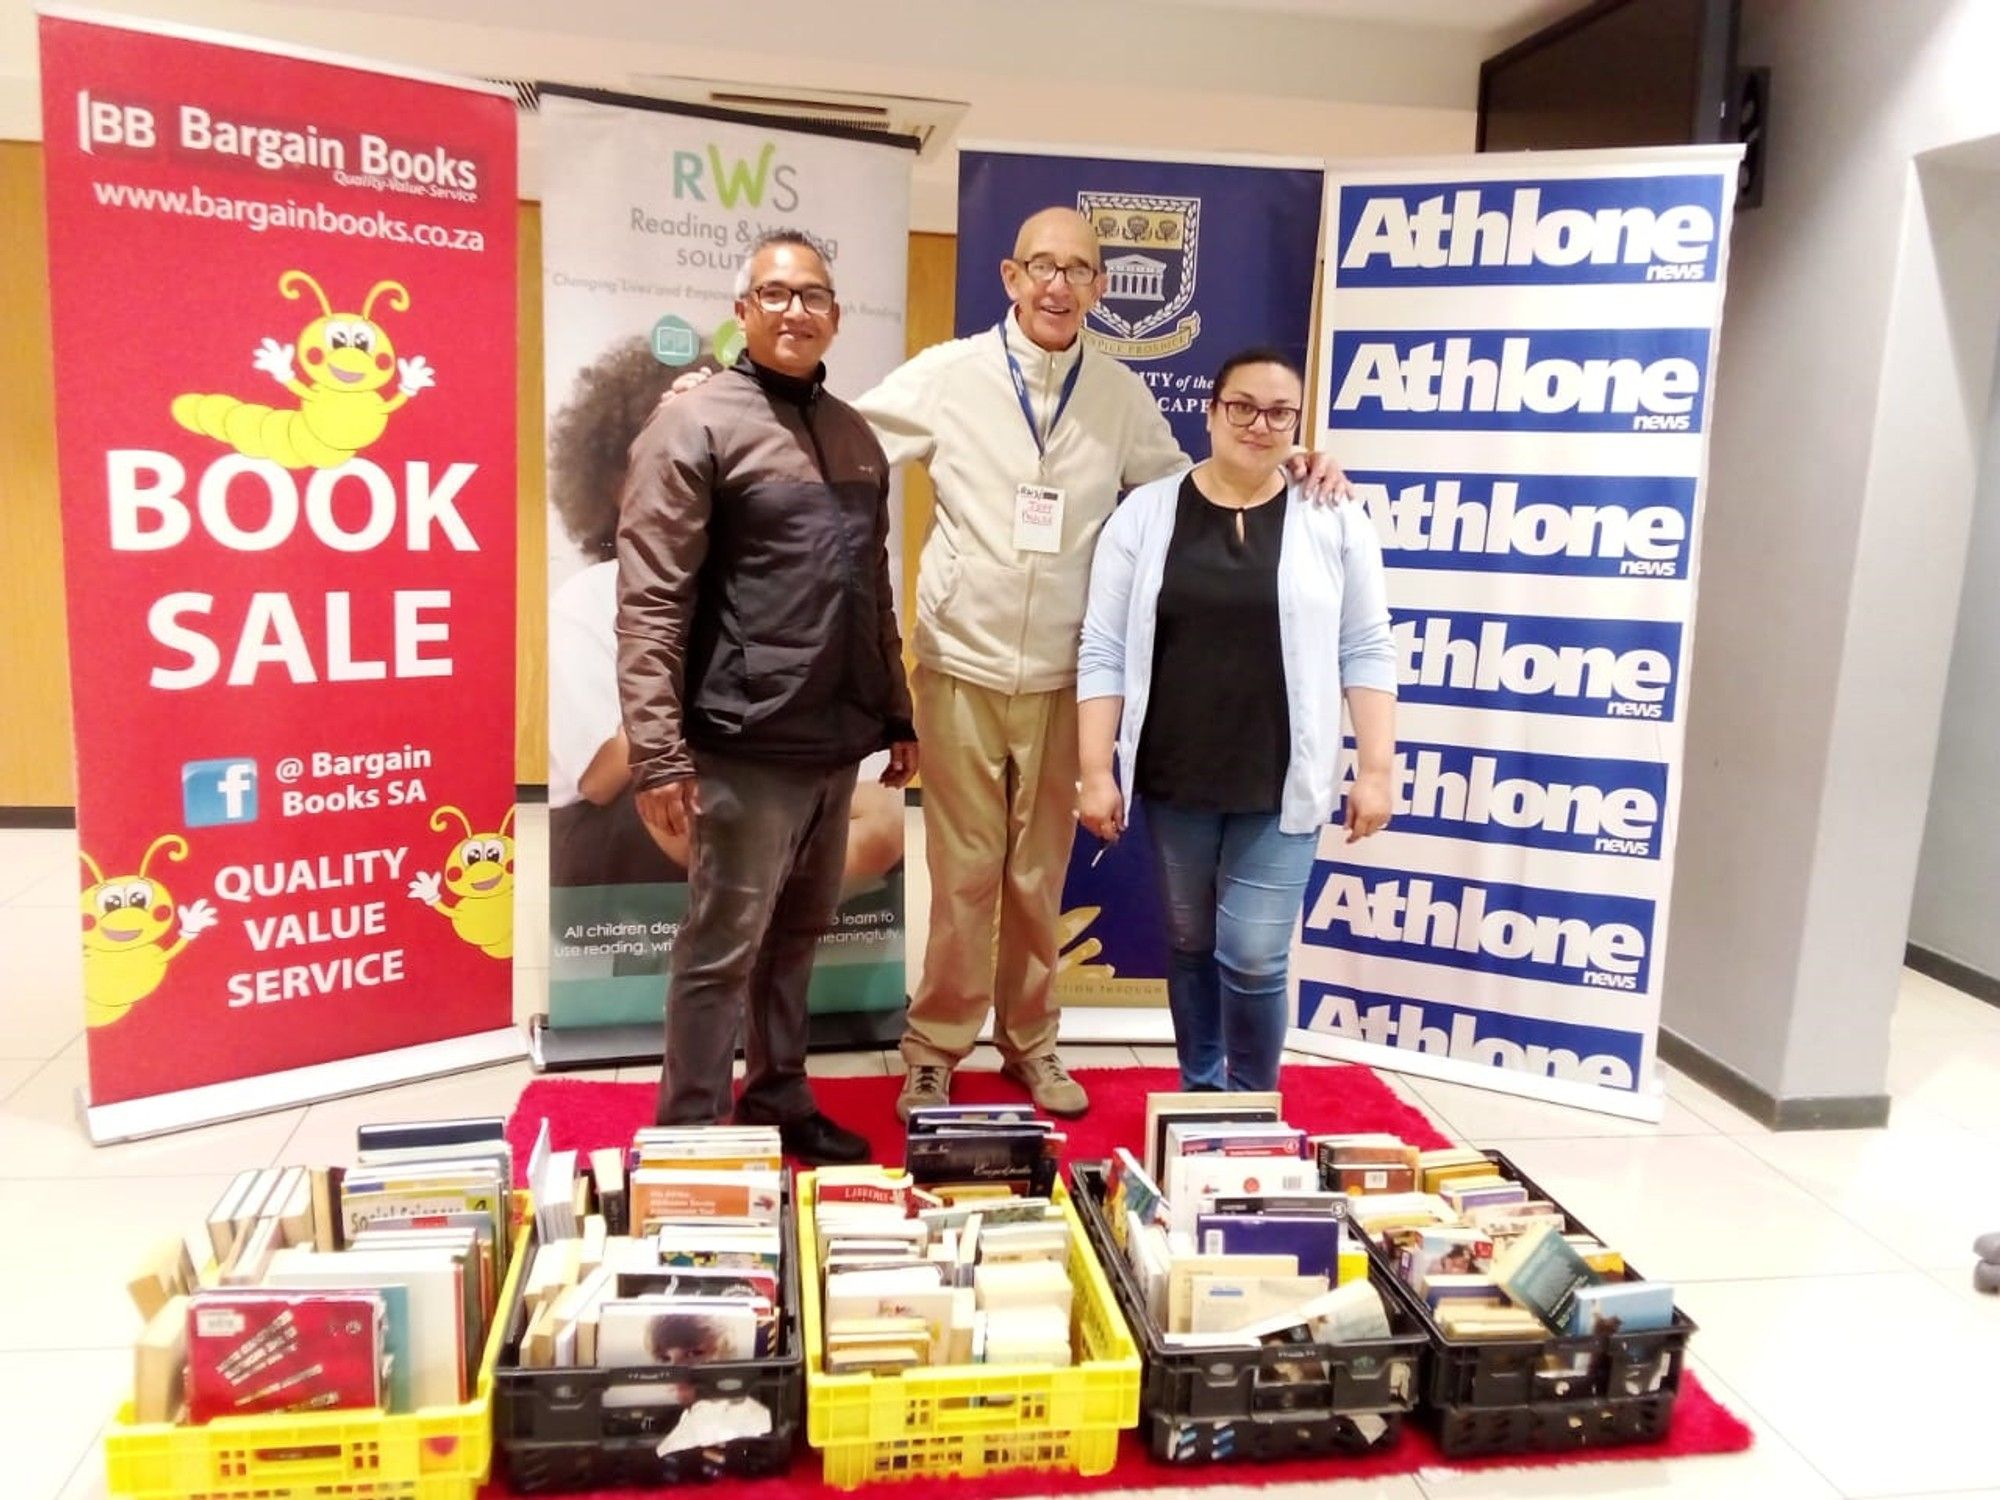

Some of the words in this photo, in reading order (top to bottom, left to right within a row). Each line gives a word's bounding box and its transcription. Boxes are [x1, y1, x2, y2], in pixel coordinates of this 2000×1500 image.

[179, 105, 345, 170] Bargain
[359, 134, 478, 190] Books
[672, 142, 800, 213] RWS
[92, 181, 486, 252] www.bargainbooks.co.za
[630, 207, 728, 246] Reading
[735, 219, 752, 243] &
[1340, 187, 1714, 269] Athlone
[676, 249, 747, 271] SOLUT
[1645, 263, 1705, 281] news
[1175, 374, 1192, 392] of
[1193, 375, 1214, 390] the
[1332, 337, 1701, 414] Athlone
[1157, 396, 1212, 414] CAPE
[1632, 414, 1691, 431] news
[106, 449, 481, 552] BOOK
[1619, 560, 1677, 577] news
[147, 589, 454, 690] SALE
[1389, 617, 1672, 702] thlone
[1606, 701, 1663, 719] news
[275, 757, 304, 784] @
[312, 745, 432, 781] Bargain
[282, 784, 381, 817] Books
[387, 779, 427, 807] SA
[1594, 837, 1650, 857] news
[214, 846, 410, 902] QUALITY
[243, 901, 386, 952] VALUE
[564, 924, 583, 939] All
[585, 922, 648, 938] children
[842, 912, 878, 925] learn
[881, 911, 895, 923] to
[1305, 872, 1646, 973] Athlone
[554, 944, 580, 957] use
[226, 948, 406, 1008] SERVICE
[1582, 970, 1637, 990] news
